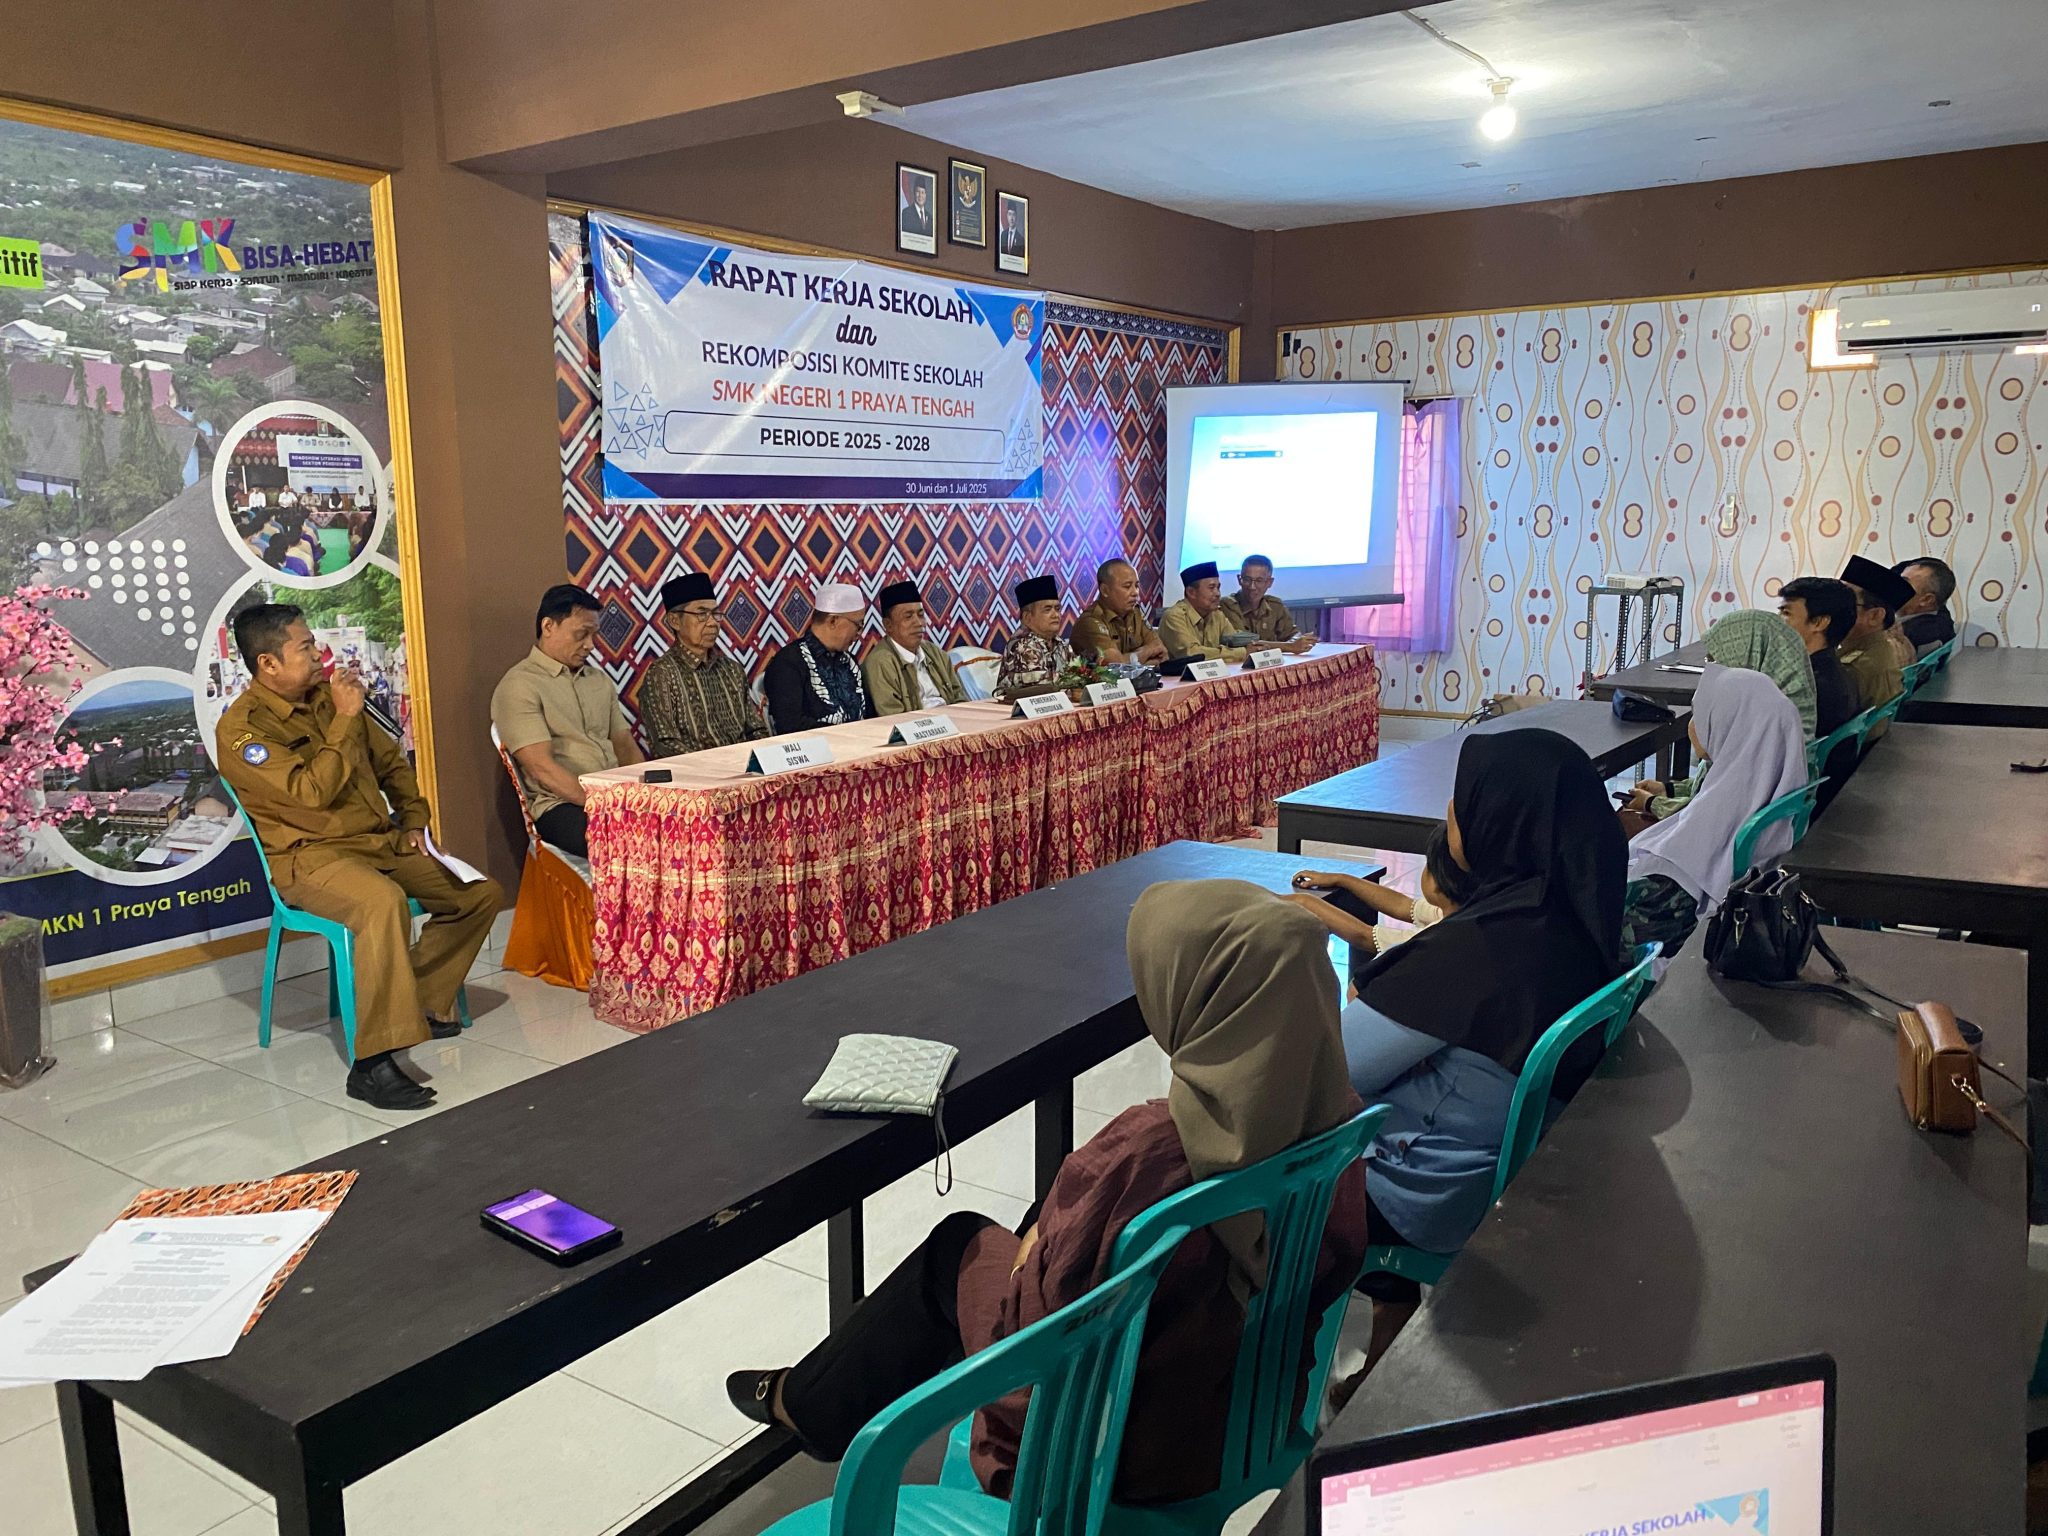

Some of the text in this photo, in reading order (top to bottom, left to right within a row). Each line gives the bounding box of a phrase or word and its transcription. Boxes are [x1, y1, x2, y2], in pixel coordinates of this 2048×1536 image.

[0, 249, 38, 278] itif
[242, 240, 372, 271] BISA-HEBAT
[708, 260, 973, 325] RAPAT KERJA SEKOLAH
[835, 314, 877, 347] dan
[702, 340, 984, 389] REKOMPOSISI KOMITE SEKOLAH
[712, 379, 975, 419] SMK NEGERI 1 PRAYA TENGAH
[760, 427, 840, 449] PERIODE
[844, 432, 882, 450] 2025
[895, 434, 931, 452] 2028
[905, 482, 987, 494] 30 Juni dan 1 Juli 2025
[913, 726, 949, 740] MASYARAKAT
[782, 742, 802, 754] WALI
[786, 754, 810, 767] SISWA
[41, 878, 251, 936] MKN 1 Praya Tengah
[1632, 1509, 1706, 1536] SEKOLAH
